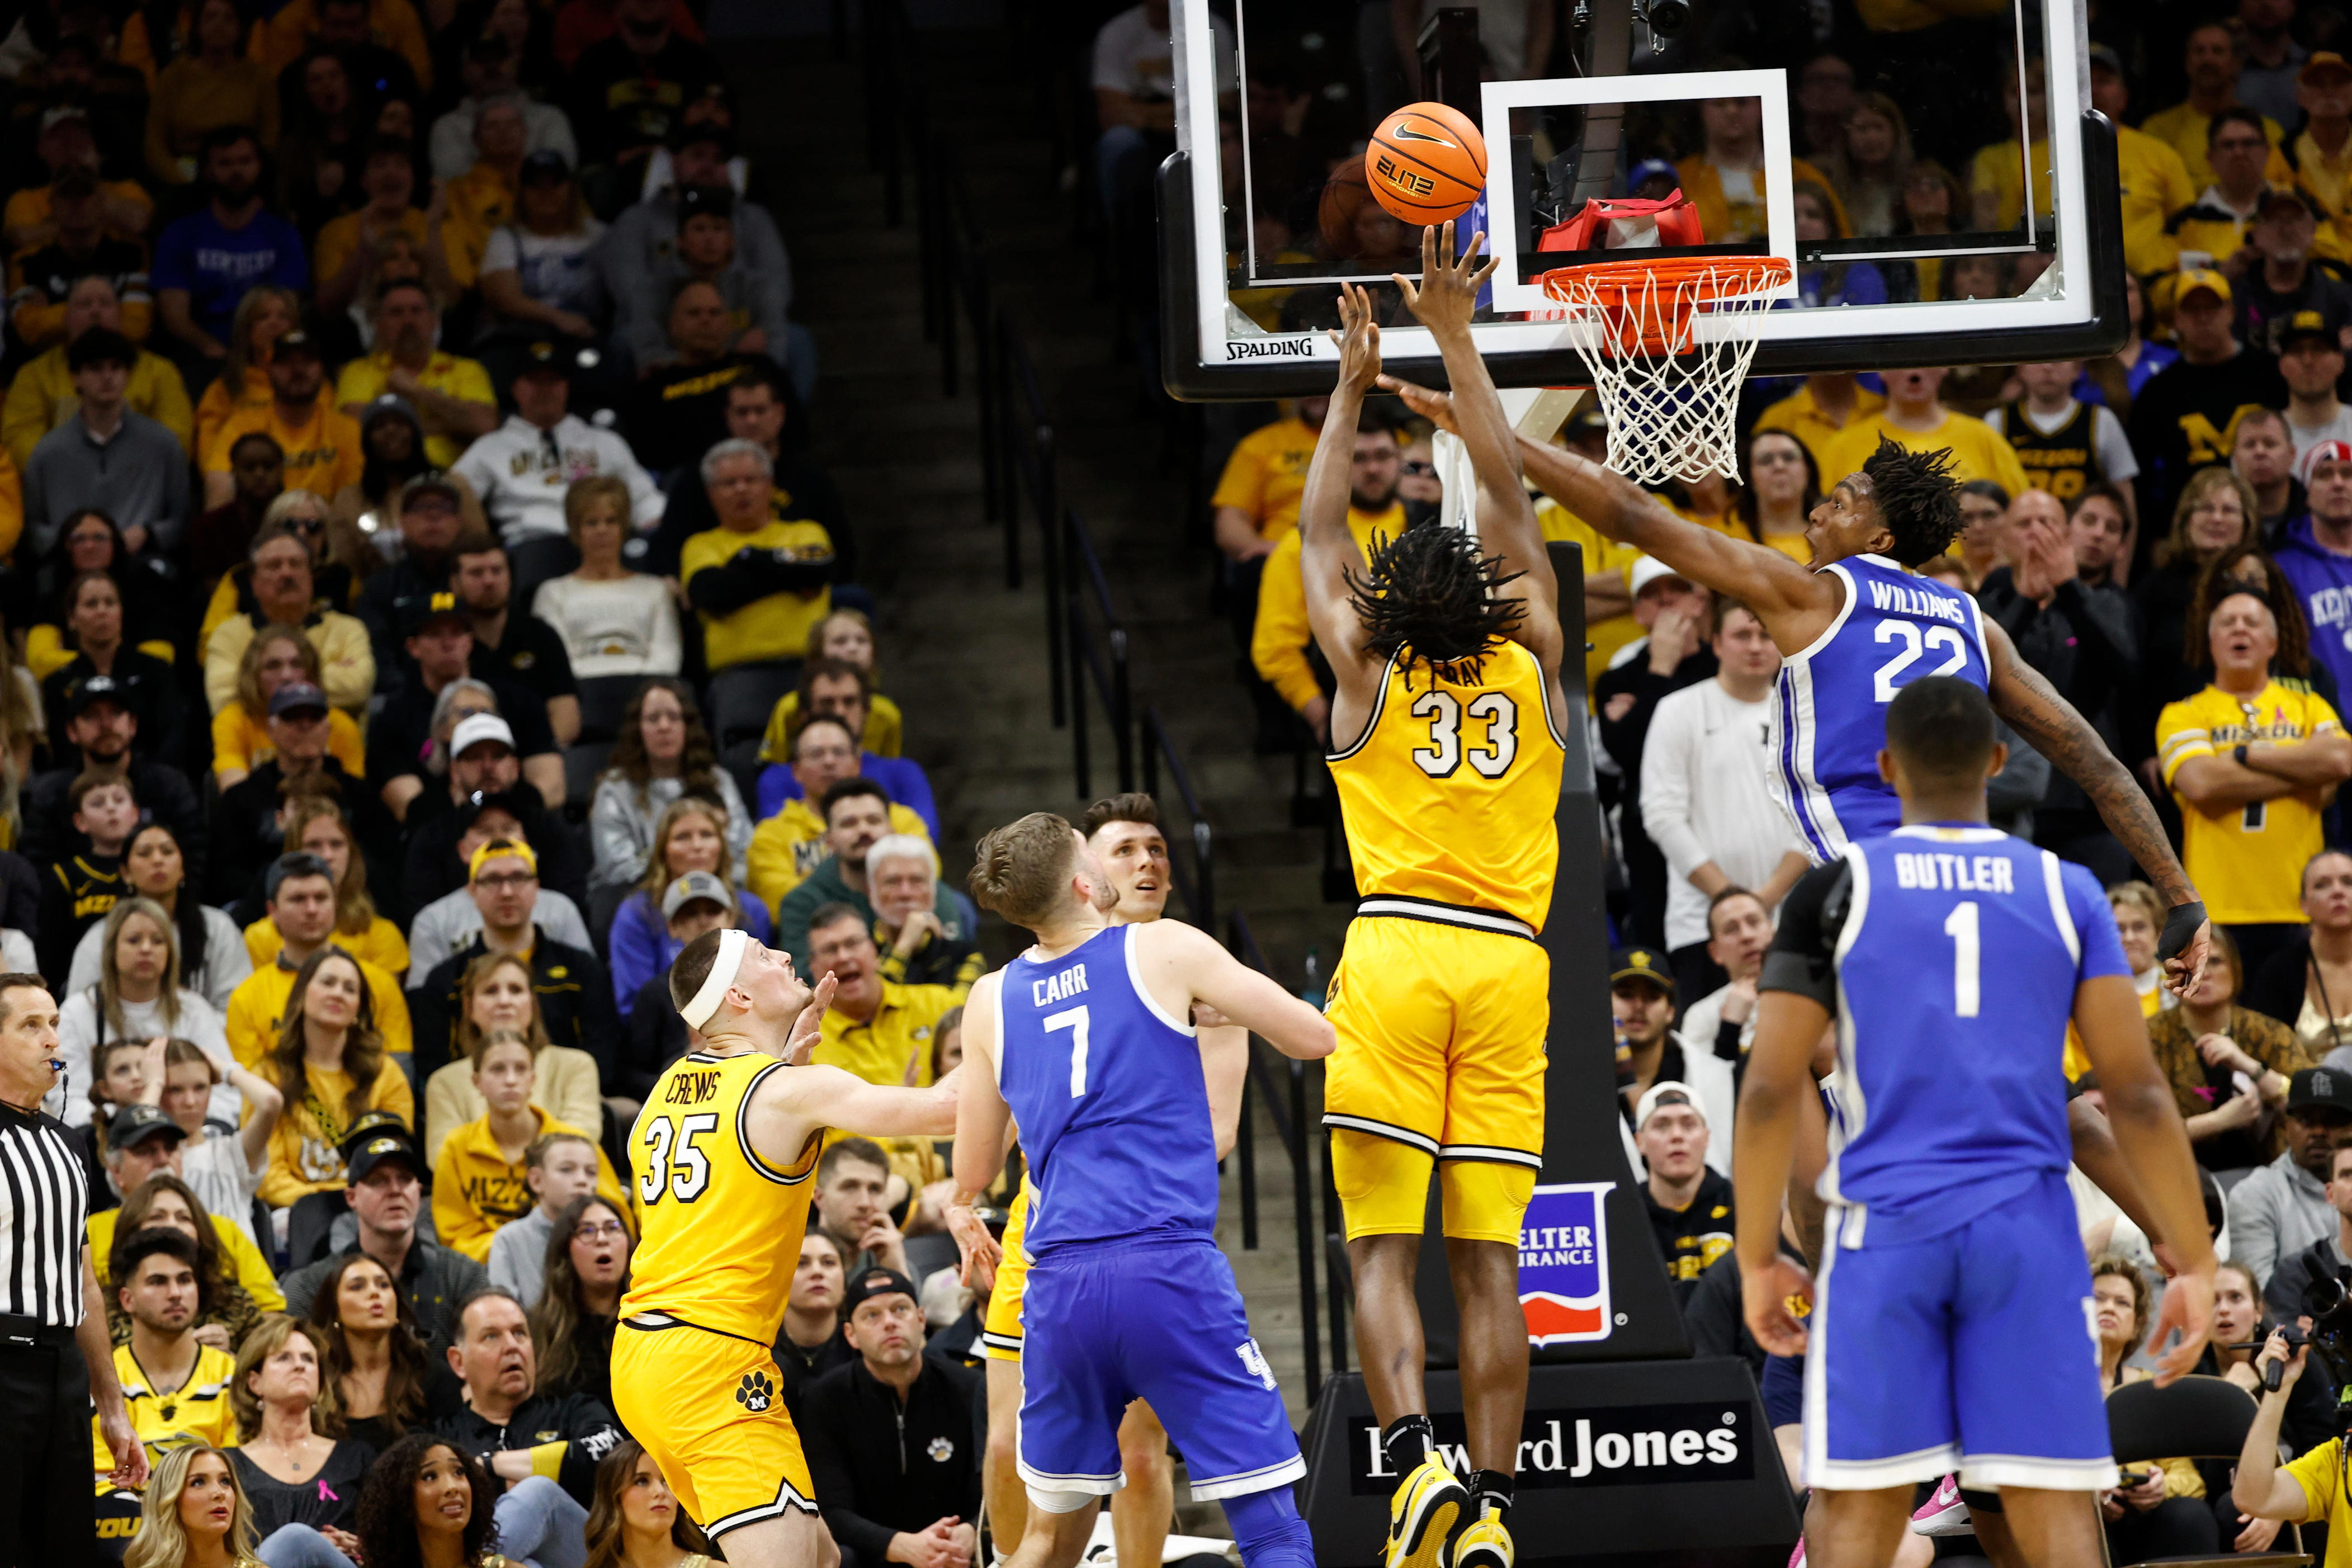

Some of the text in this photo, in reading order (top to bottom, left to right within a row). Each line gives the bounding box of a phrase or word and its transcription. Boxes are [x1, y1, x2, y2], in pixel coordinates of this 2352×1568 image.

[1376, 155, 1436, 196] ELITE
[1376, 170, 1430, 201] MPIONSHIP
[1227, 337, 1312, 361] SPALDING
[1868, 580, 1965, 624] WILLIAMS
[1433, 660, 1486, 687] RAY
[1873, 618, 1967, 702] 22
[1411, 691, 1518, 779] 33
[1895, 853, 2014, 894] BUTLER
[1944, 901, 1980, 1018] 1
[1033, 963, 1089, 1007] CARR
[1043, 1004, 1090, 1099] 7
[665, 1071, 721, 1104] CREWS
[641, 1112, 720, 1205] 35
[1518, 1226, 1594, 1250] ELTER
[1518, 1249, 1594, 1268] RANCE
[749, 1396, 767, 1410] M
